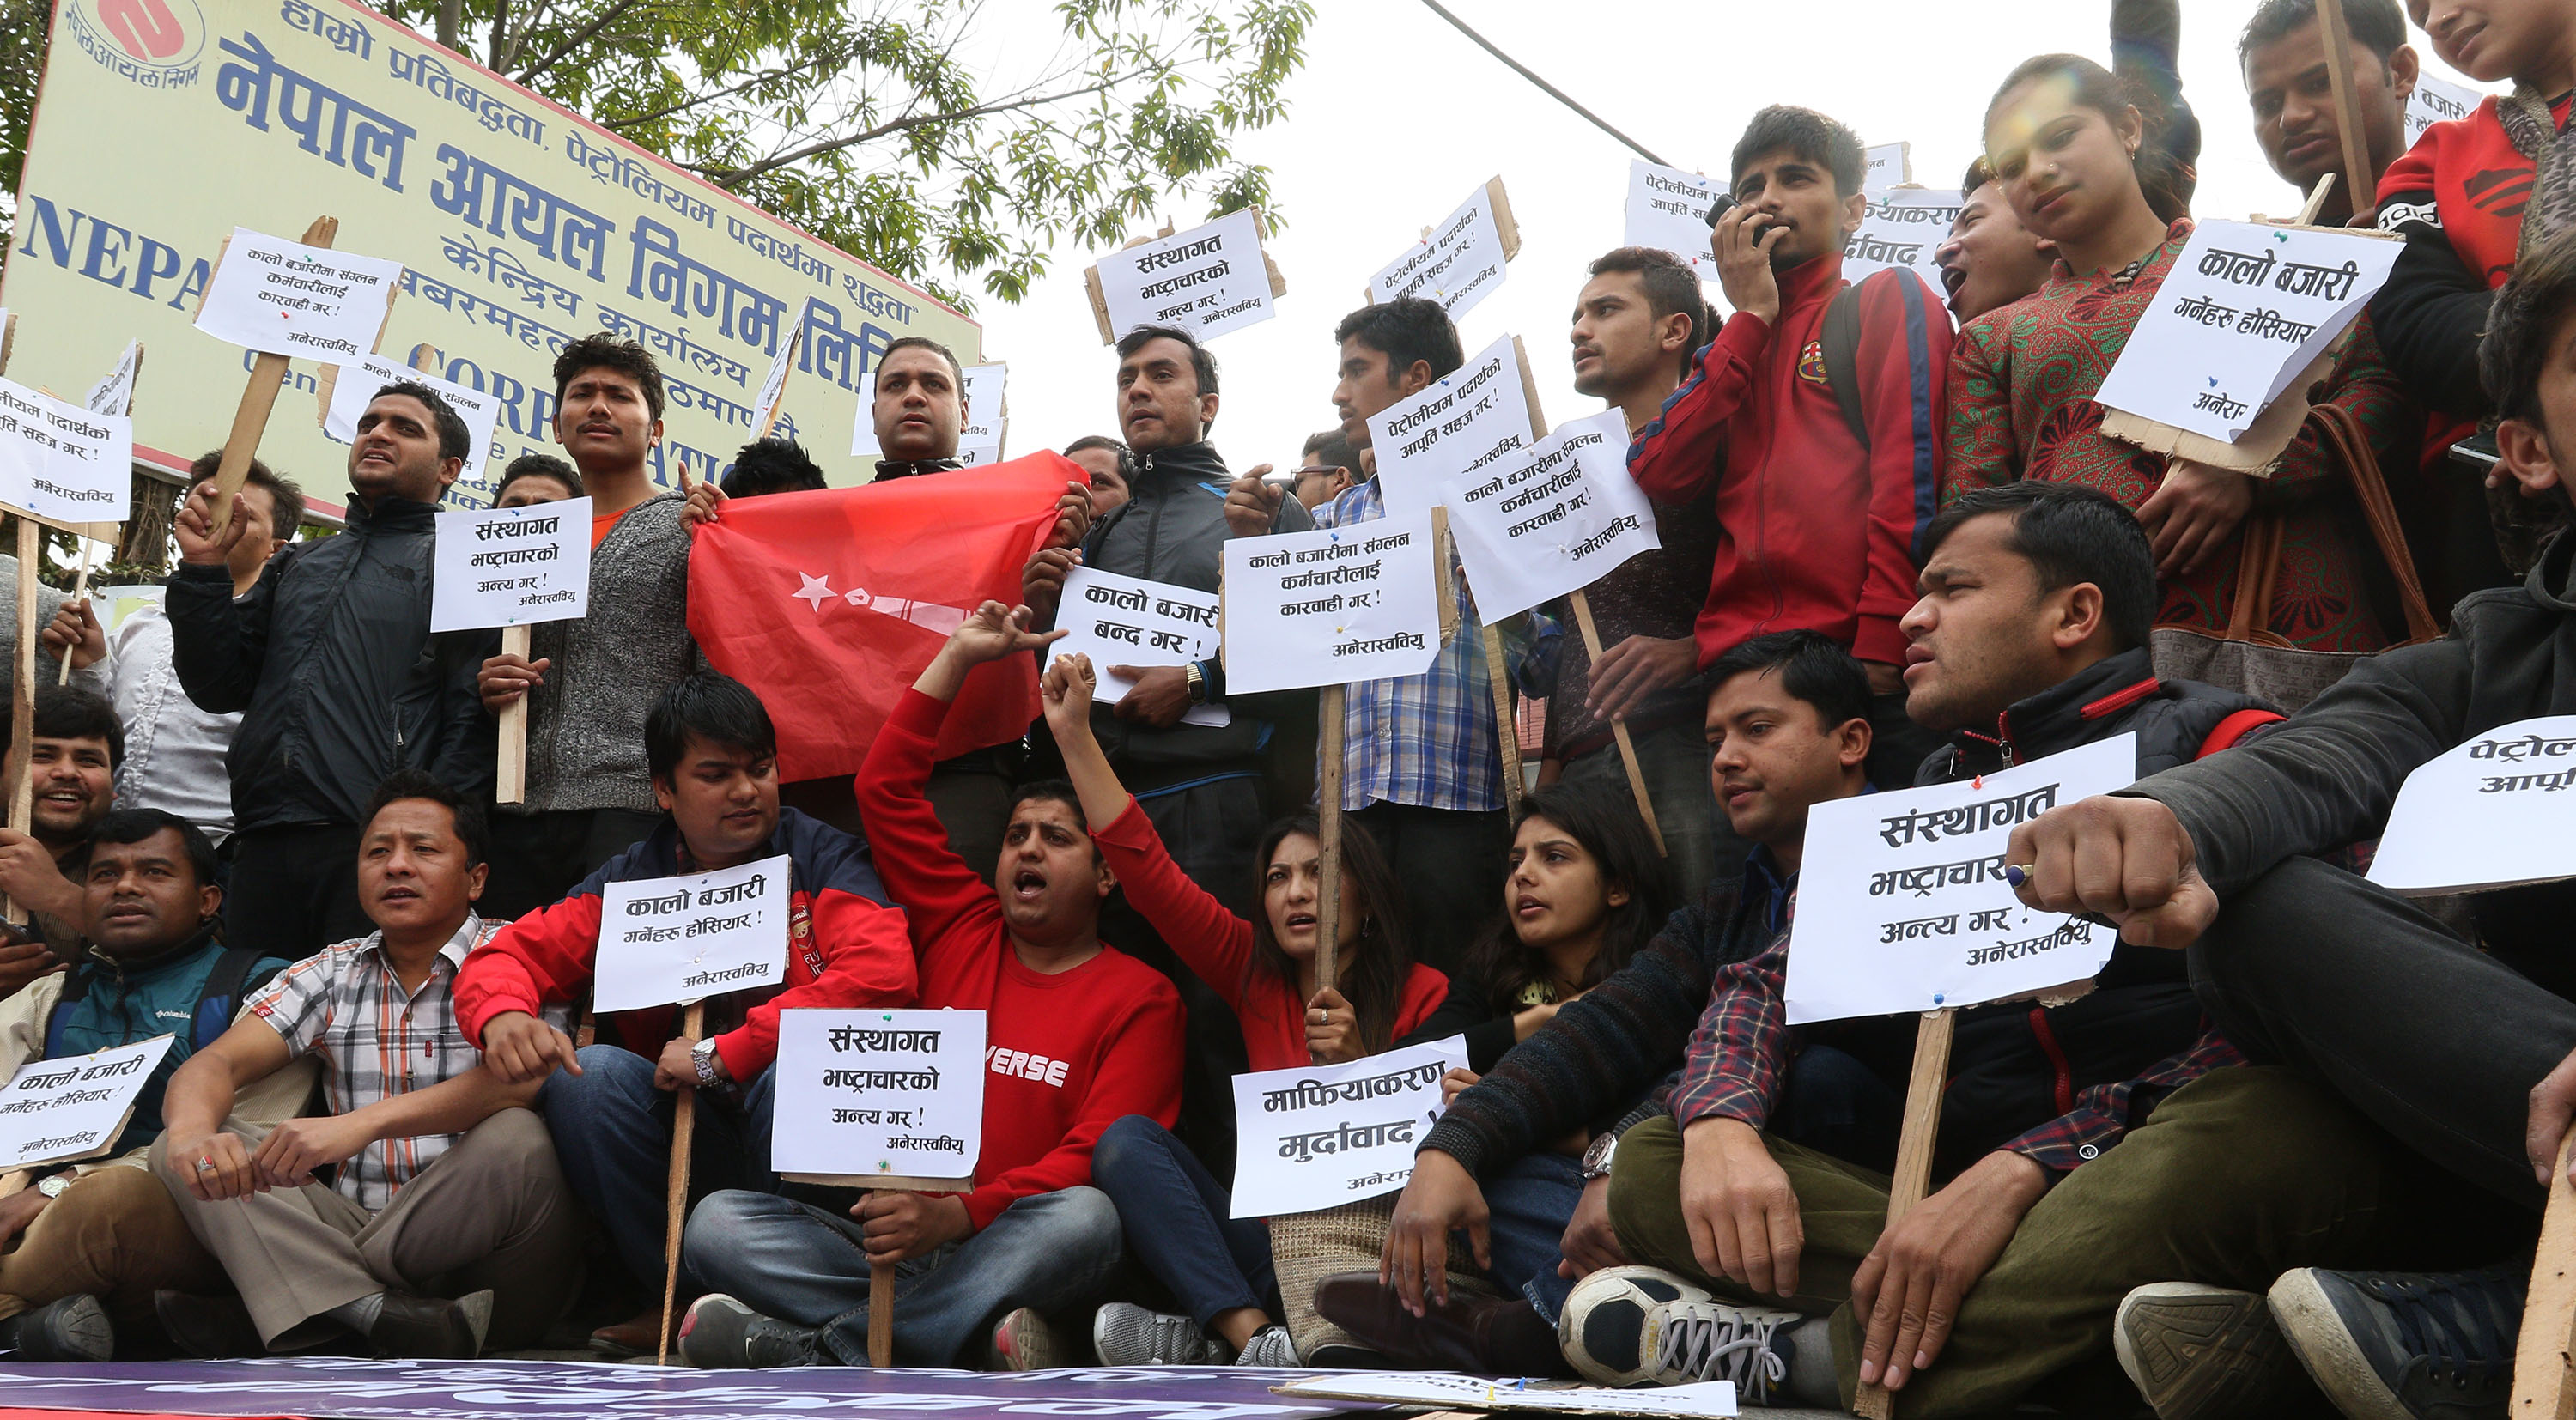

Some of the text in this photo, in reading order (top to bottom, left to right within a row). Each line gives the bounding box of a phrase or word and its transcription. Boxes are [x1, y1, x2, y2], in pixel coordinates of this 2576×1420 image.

[280, 0, 376, 62] हाम्रो
[564, 129, 720, 229] पेट्रोलियम
[727, 214, 836, 288] पदार्थमा
[216, 30, 417, 195] नेपाल
[429, 143, 616, 284] आयल
[629, 215, 787, 358] निगम
[19, 194, 210, 312] NEPA
[248, 248, 284, 266] कालो
[285, 258, 336, 278] बजारीमा
[1135, 234, 1223, 274] संस्थागत
[266, 270, 350, 299] कर्मचारीलाई
[2197, 247, 2360, 302] कालो बजारी
[258, 290, 310, 311] कारवाही
[597, 302, 752, 389] कार्यालय
[22, 425, 58, 450] सहज
[46, 410, 112, 440] पदार्थको
[1441, 414, 1473, 437] सहज
[1463, 477, 1504, 504] कालो
[1506, 451, 1563, 486] बजारीमा
[475, 516, 560, 541] संस्थागत
[1508, 502, 1567, 539] कारवाही
[1249, 532, 1411, 568] कालो बजारीमा संग्लन
[477, 579, 515, 592] अन्त्य
[1281, 560, 1382, 591] कर्मचारीलाई
[1085, 584, 1151, 612] कालो
[1280, 595, 1344, 616] कारवाही
[1376, 589, 1381, 604] !
[1094, 619, 1145, 646] बन्द
[1194, 640, 1201, 658] !
[1880, 782, 2061, 848] संस्थागत
[625, 874, 767, 917] कालो बजारी
[1880, 913, 1960, 944] अन्त्य
[829, 1024, 941, 1053] संस्थागत
[18, 1054, 146, 1091] कालो बजारी
[1262, 1060, 1446, 1113] माफियाकरण
[832, 1108, 881, 1126] अन्त्य
[918, 1107, 924, 1126] !
[886, 1134, 964, 1156] अनेरास्ववियु
[1279, 1120, 1416, 1162] मुर्दावाद
